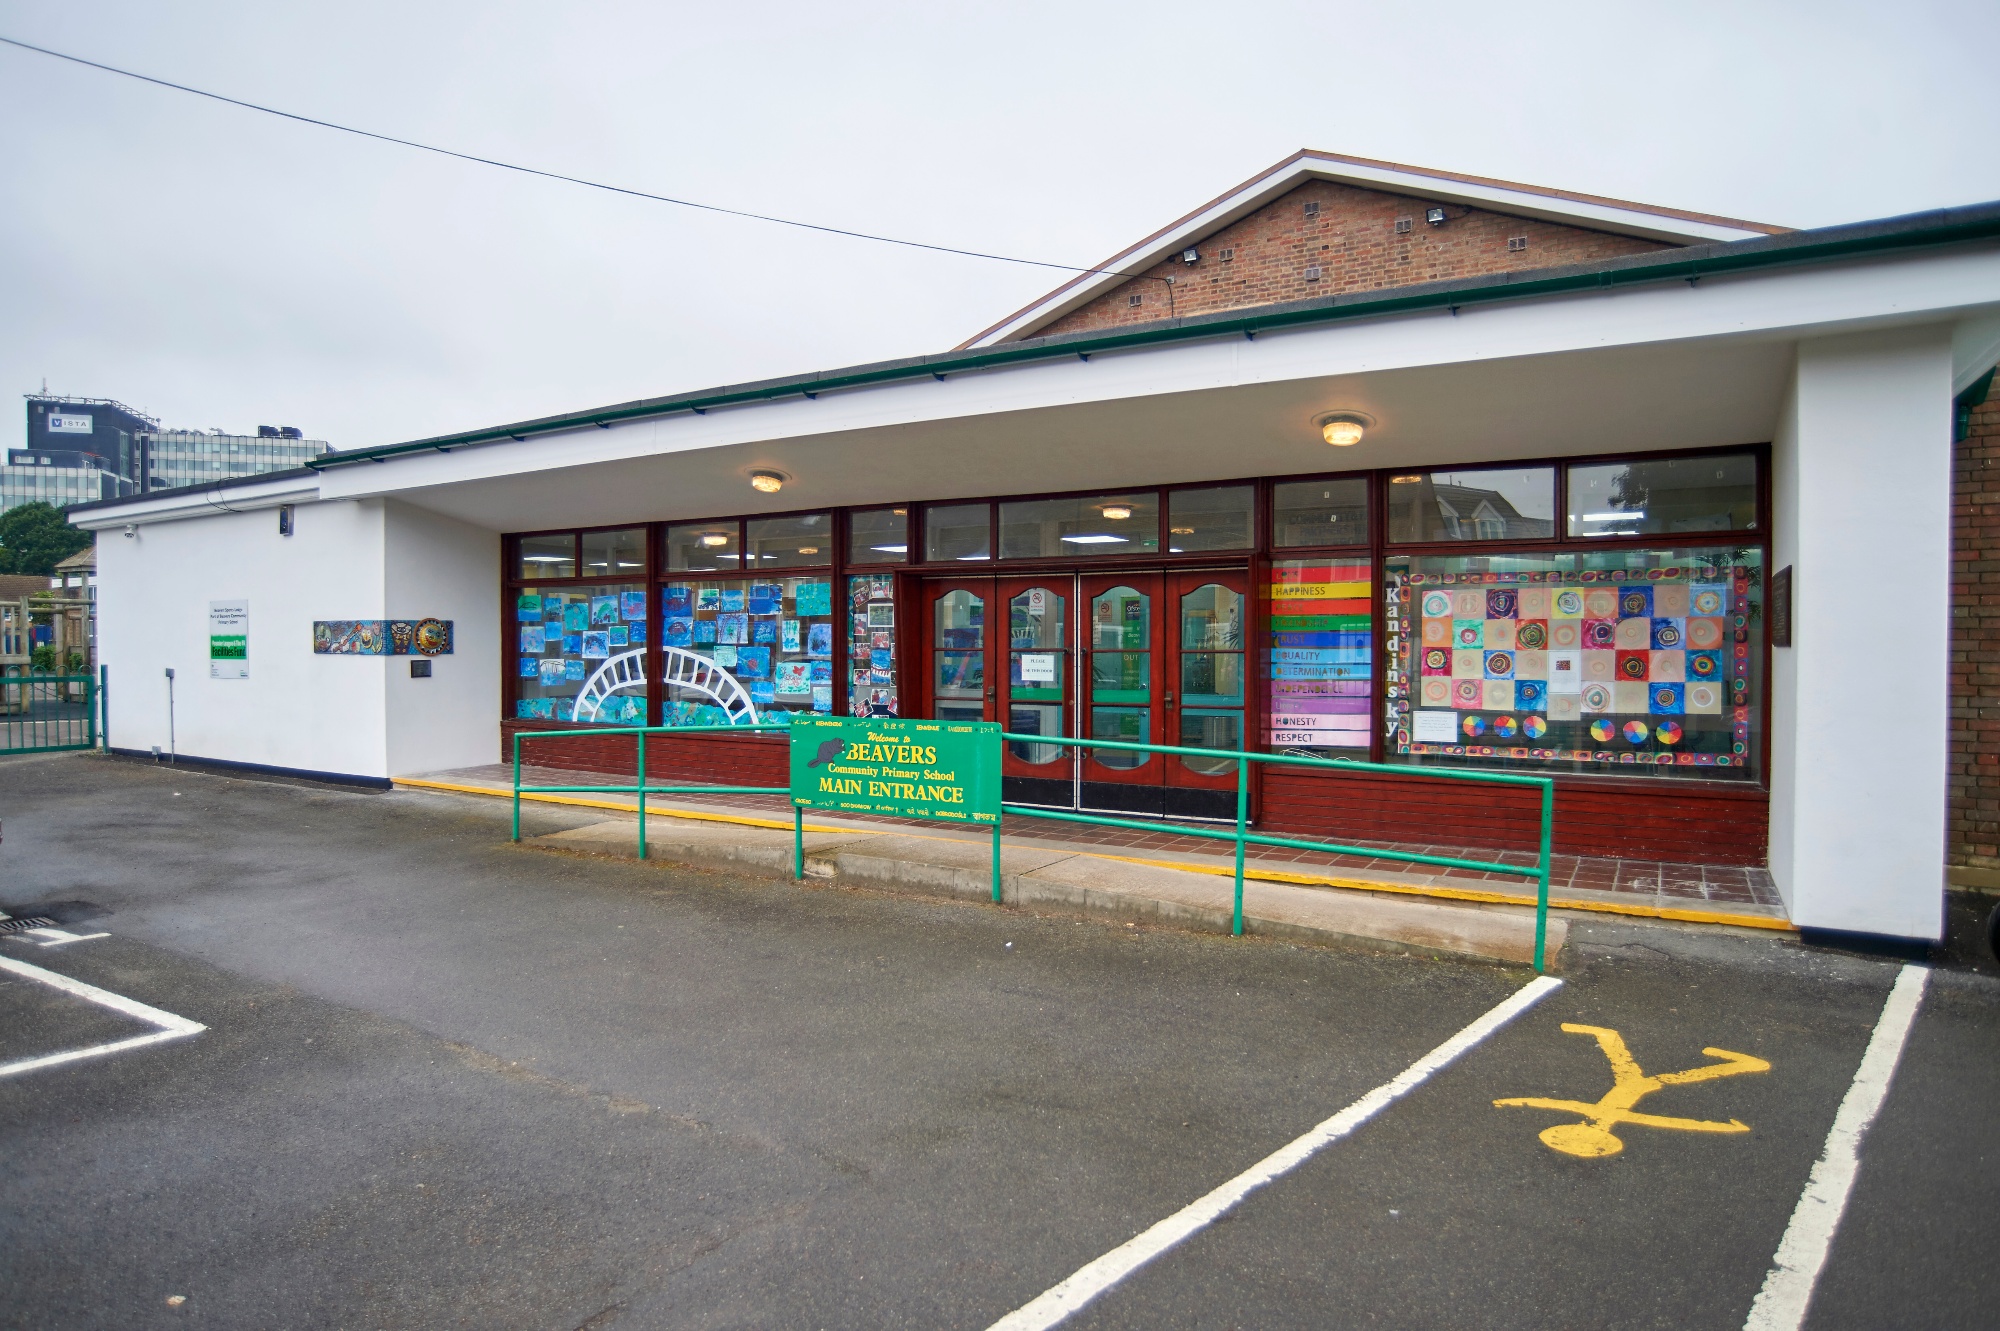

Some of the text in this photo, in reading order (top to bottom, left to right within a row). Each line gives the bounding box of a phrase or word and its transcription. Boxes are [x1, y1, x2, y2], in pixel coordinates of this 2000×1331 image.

[53, 419, 87, 427] VISTA
[1275, 586, 1326, 596] HAPPINESS
[1276, 604, 1303, 612] PEACE
[1275, 619, 1328, 628] FRIENDSHIP
[212, 647, 246, 657] Facilities Fund
[1275, 651, 1320, 661] EQUALITY
[1385, 587, 1400, 737] Kandinsky
[1275, 668, 1351, 677] DETERMINATION
[1275, 684, 1344, 694] INDEPENDENCE
[1275, 717, 1317, 726] HONESTY
[867, 731, 911, 743] Welcome to
[1275, 733, 1313, 742] RESPECT
[846, 742, 937, 765] BEAVERS
[828, 762, 955, 782] Community Primary School
[818, 777, 964, 803] MAIN ENTRANCE
